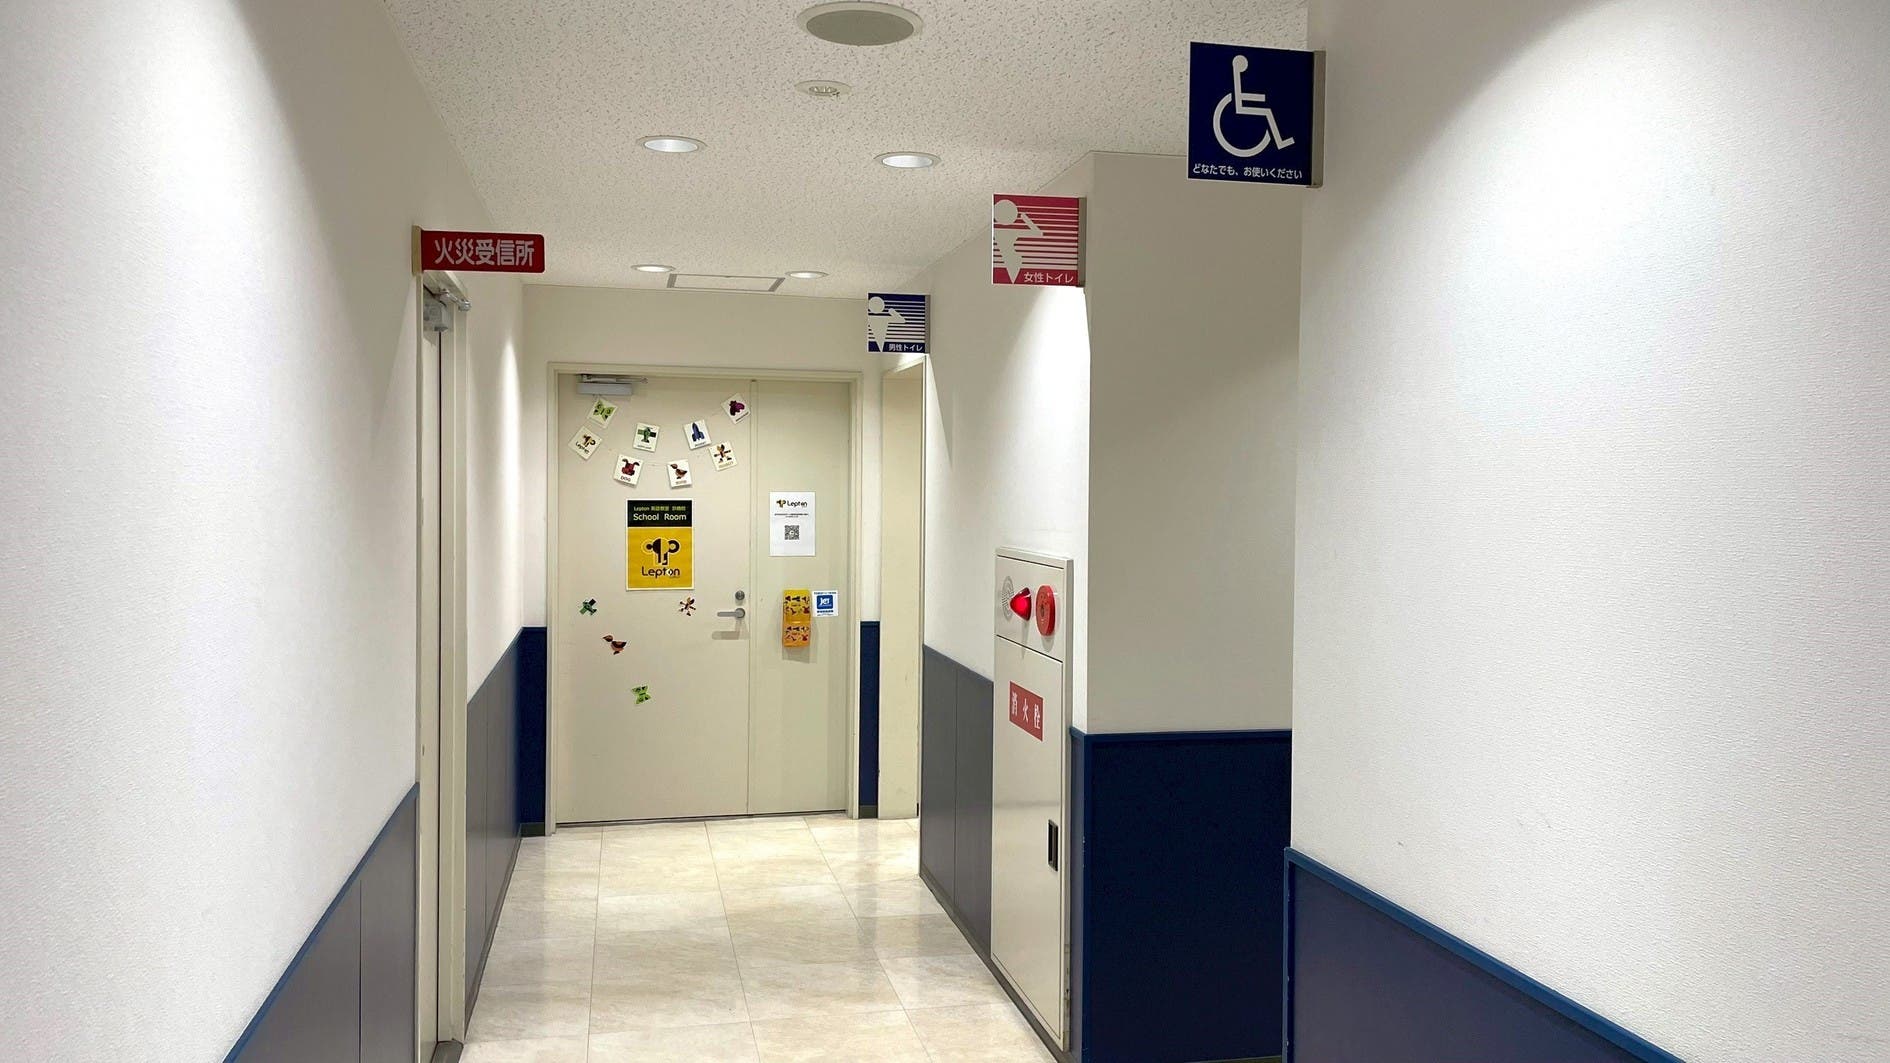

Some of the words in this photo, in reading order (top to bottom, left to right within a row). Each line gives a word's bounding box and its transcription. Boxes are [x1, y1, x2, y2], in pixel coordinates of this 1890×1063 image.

[1192, 163, 1302, 179] どなたでも、お使いください
[434, 237, 535, 267] 火災受信所
[1023, 271, 1074, 284] 女性トイレ
[888, 343, 923, 352] 男性トイレ
[633, 513, 660, 521] School
[664, 513, 687, 521] Room
[641, 566, 681, 579] Lepton
[1011, 692, 1041, 729] 消火栓
